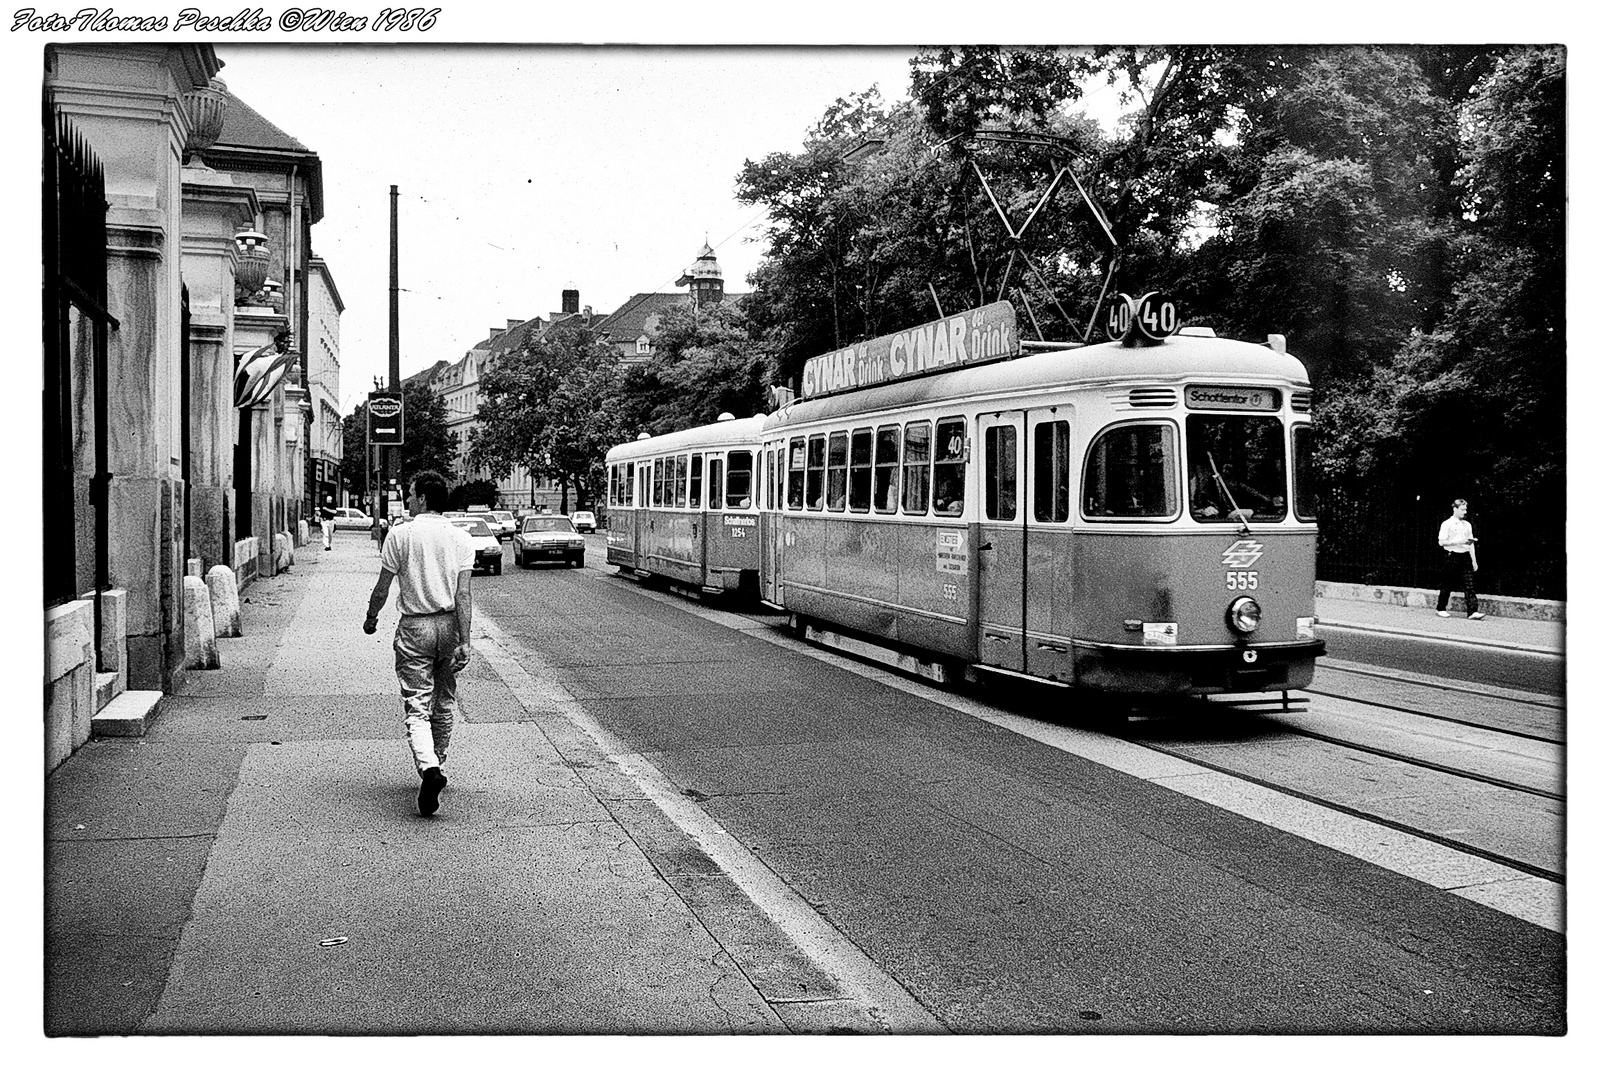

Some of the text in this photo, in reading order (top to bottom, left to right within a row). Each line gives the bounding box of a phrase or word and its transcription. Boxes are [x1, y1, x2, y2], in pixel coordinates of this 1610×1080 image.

[1109, 303, 1129, 334] 40
[1143, 301, 1175, 332] 40
[890, 317, 1010, 376] CYNAR Drink
[803, 349, 884, 396] CYNAR Drink
[948, 436, 962, 454] 40
[731, 527, 746, 538] 1254
[943, 583, 957, 600] 555
[1226, 571, 1258, 590] 555
